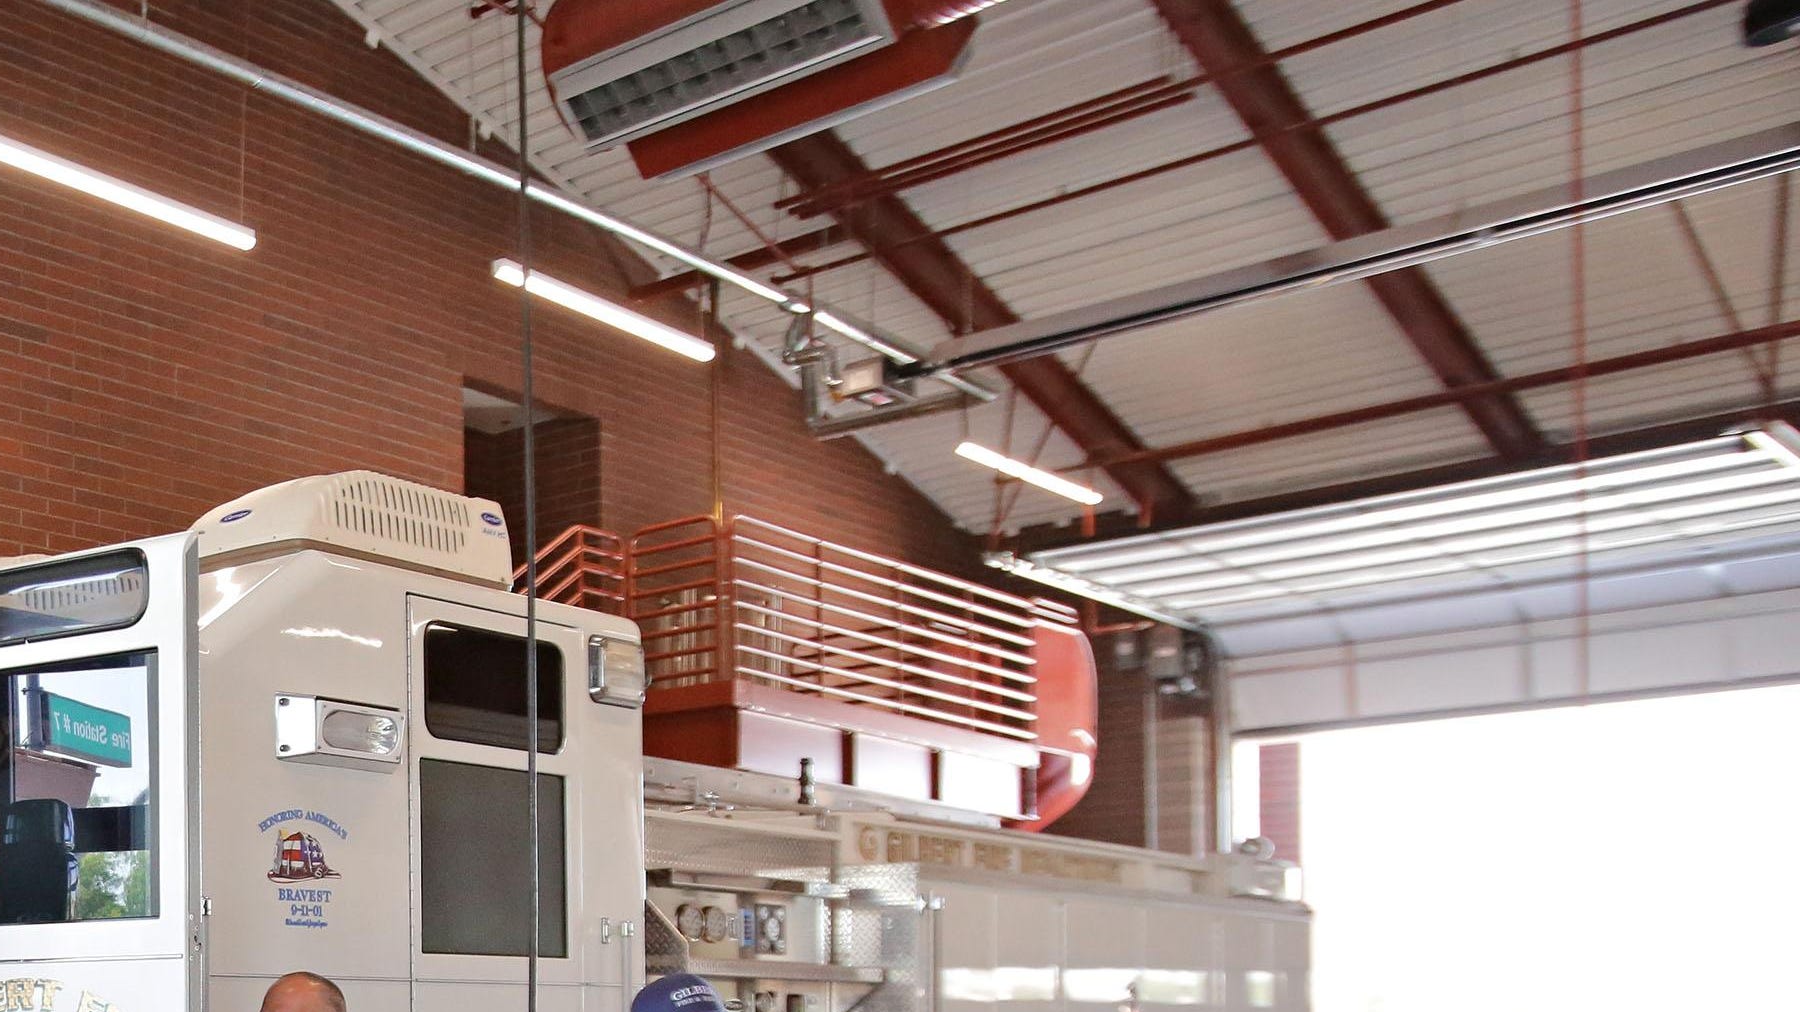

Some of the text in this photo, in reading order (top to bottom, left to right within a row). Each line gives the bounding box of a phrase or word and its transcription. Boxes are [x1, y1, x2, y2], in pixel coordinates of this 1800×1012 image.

[258, 809, 304, 833] HONORING
[278, 888, 332, 903] BRAVEST
[290, 904, 323, 917] 9-11-01
